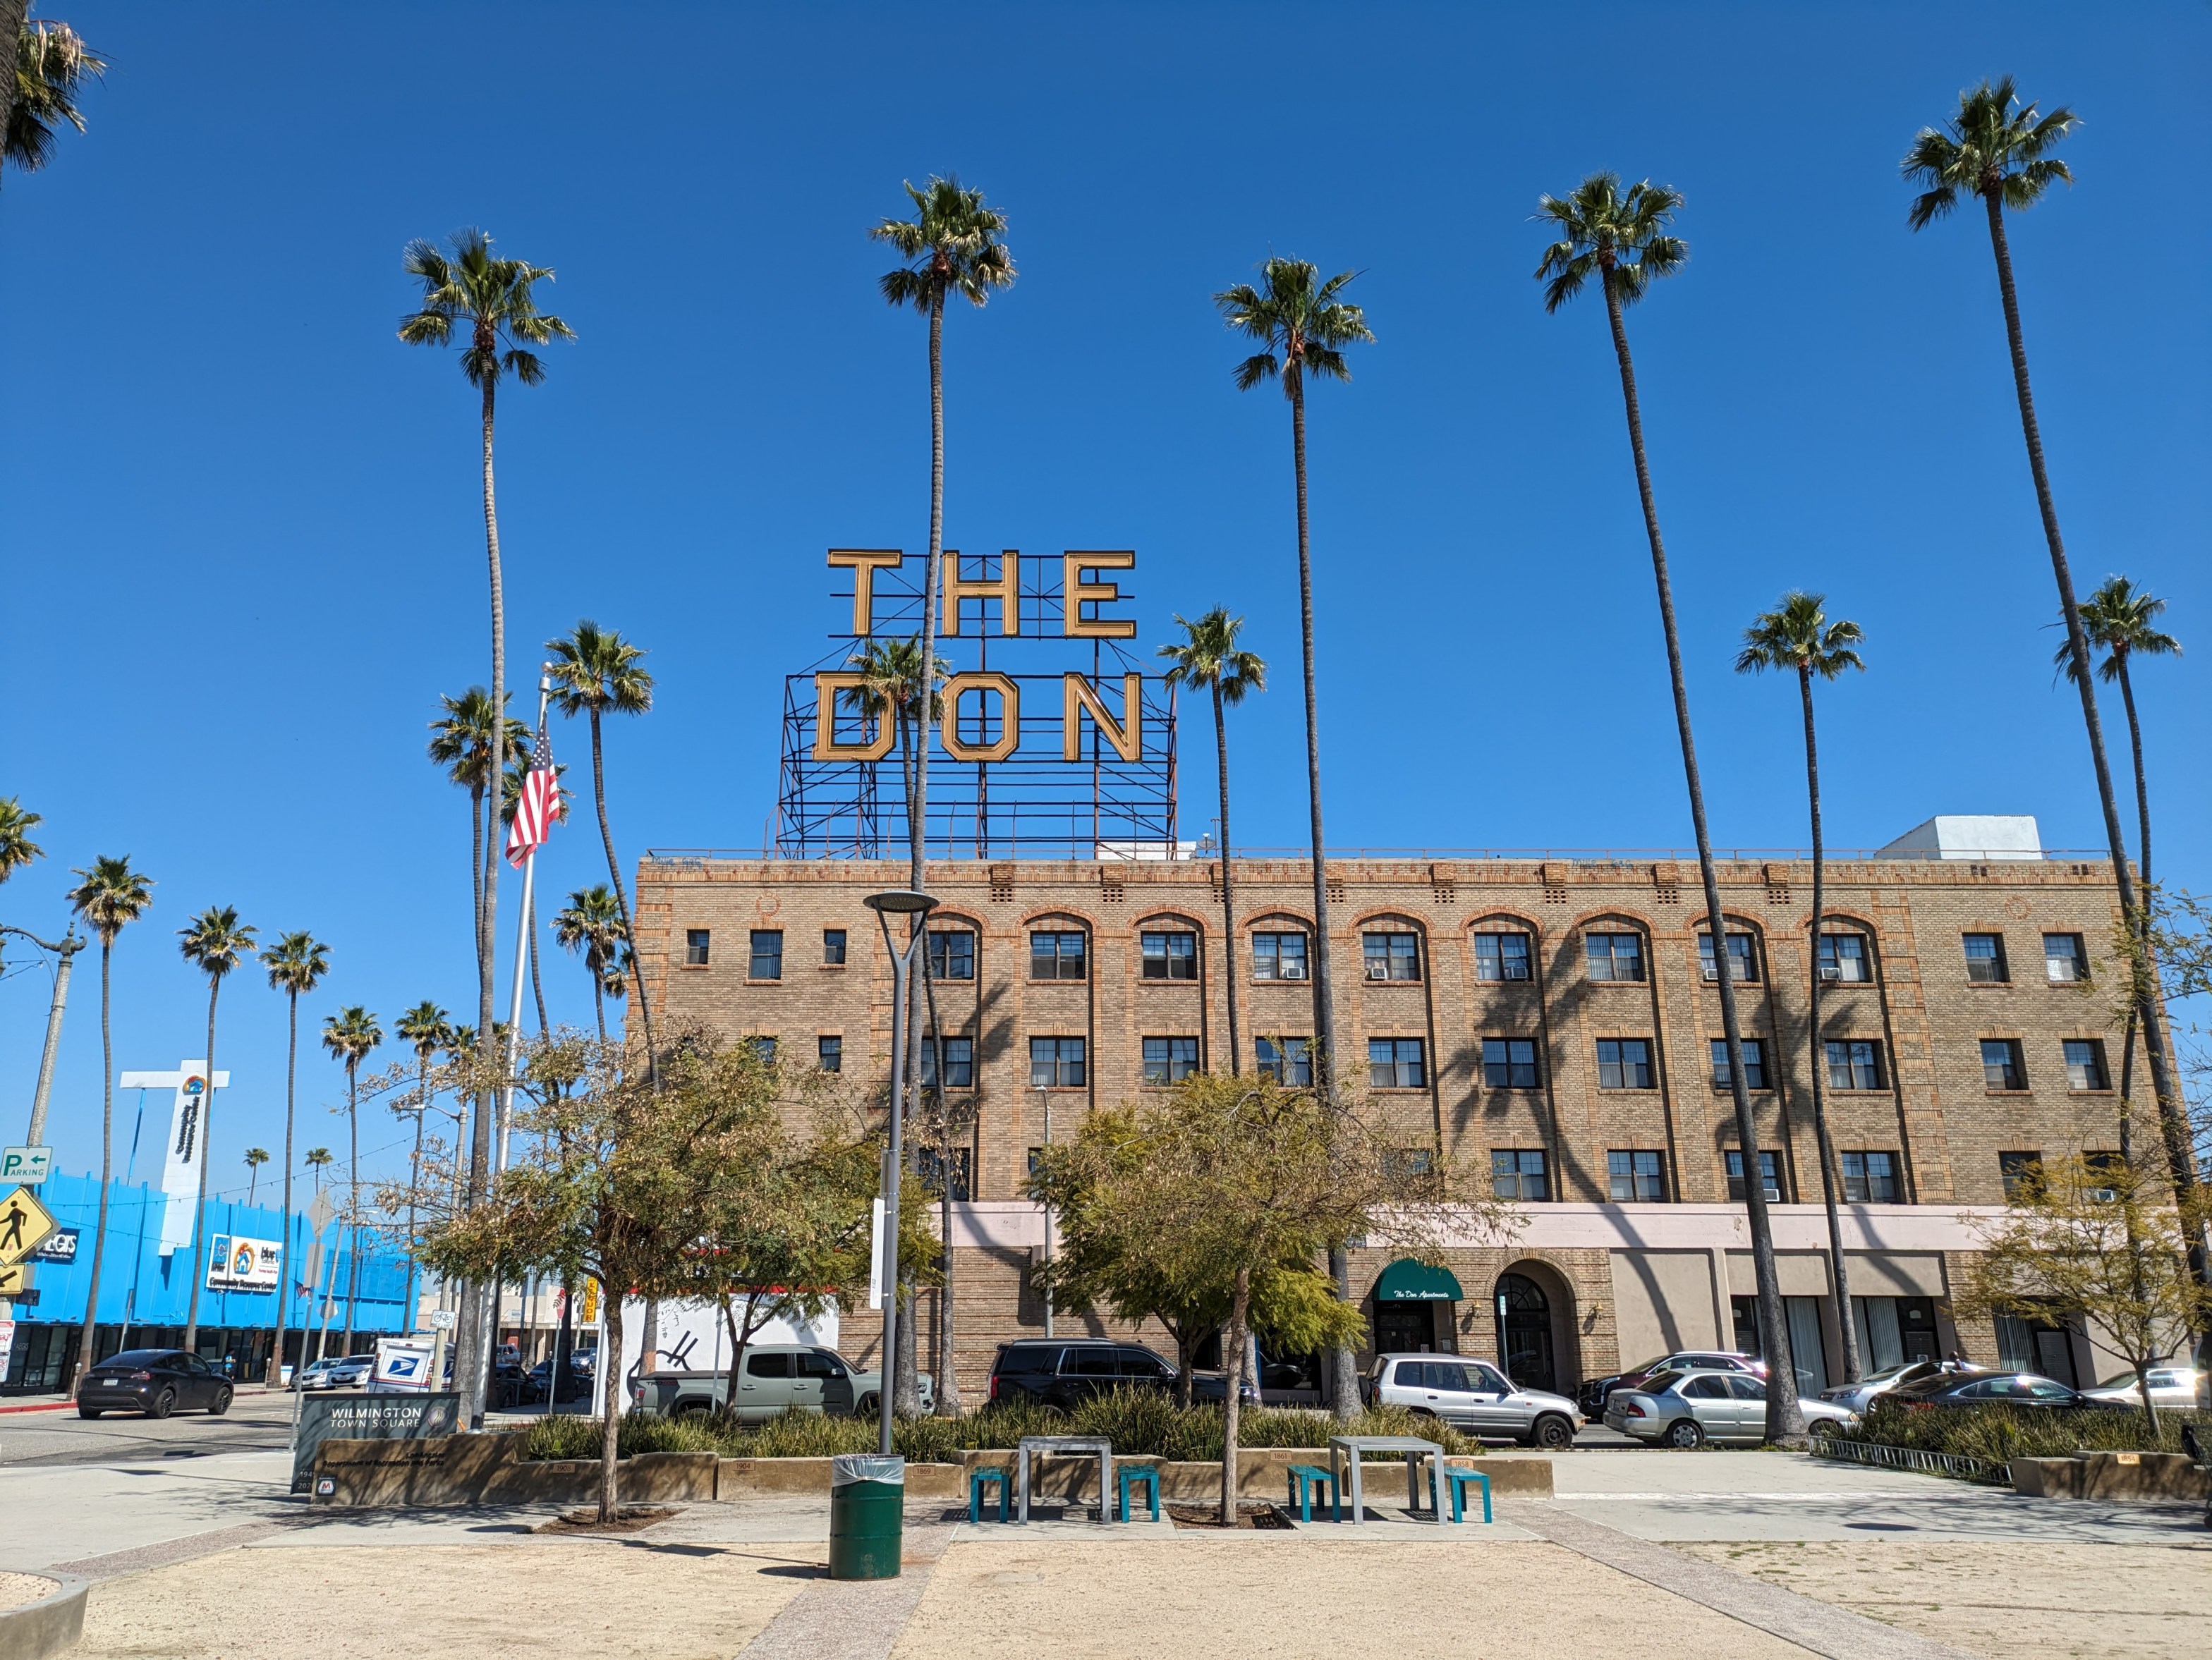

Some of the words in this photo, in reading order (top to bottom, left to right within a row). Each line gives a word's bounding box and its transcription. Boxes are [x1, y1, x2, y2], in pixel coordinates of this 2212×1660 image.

[827, 549, 1137, 640] THE
[812, 671, 1142, 763] DON
[175, 1104, 193, 1154] Community
[3, 1154, 44, 1176] PARKING
[43, 1233, 77, 1253] EGIS
[209, 1277, 240, 1290] Community
[1418, 1290, 1449, 1299] Apartments
[332, 1408, 422, 1419] WILMINGTON
[330, 1419, 366, 1428] TOWN
[372, 1418, 420, 1429] SQUARE
[322, 1460, 363, 1469] Department
